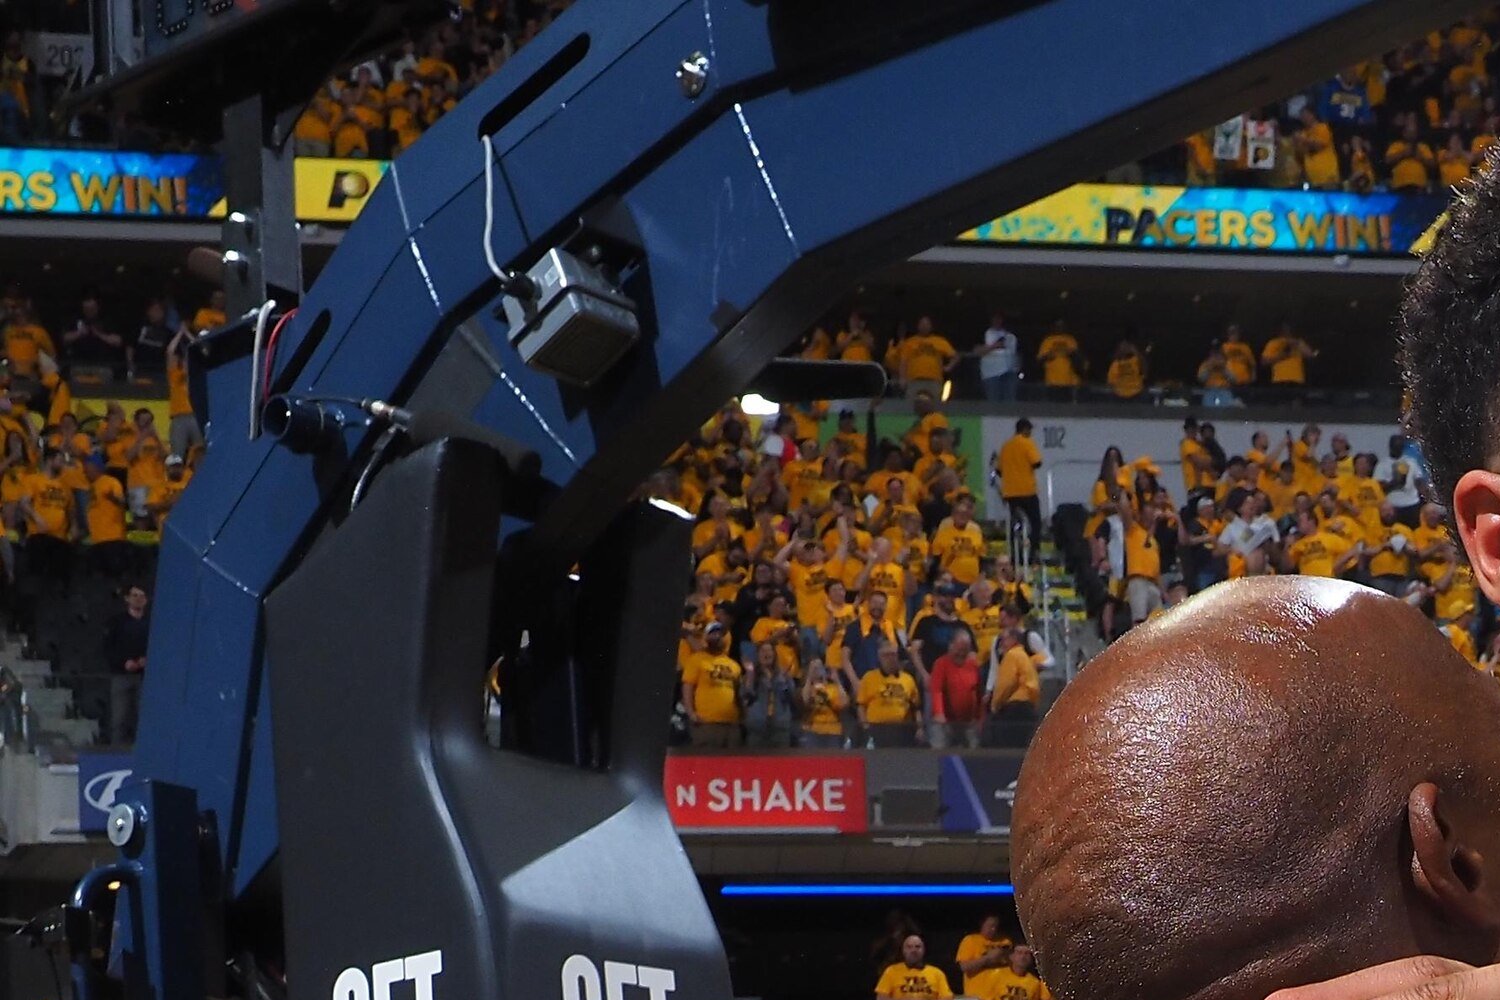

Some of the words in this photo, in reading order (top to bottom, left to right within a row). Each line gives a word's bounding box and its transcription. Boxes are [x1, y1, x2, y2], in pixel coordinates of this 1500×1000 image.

[70, 174, 188, 215] WIN!
[1103, 206, 1277, 248] PACERS
[1287, 213, 1393, 252] WIN!
[707, 778, 847, 813] SHAKE
